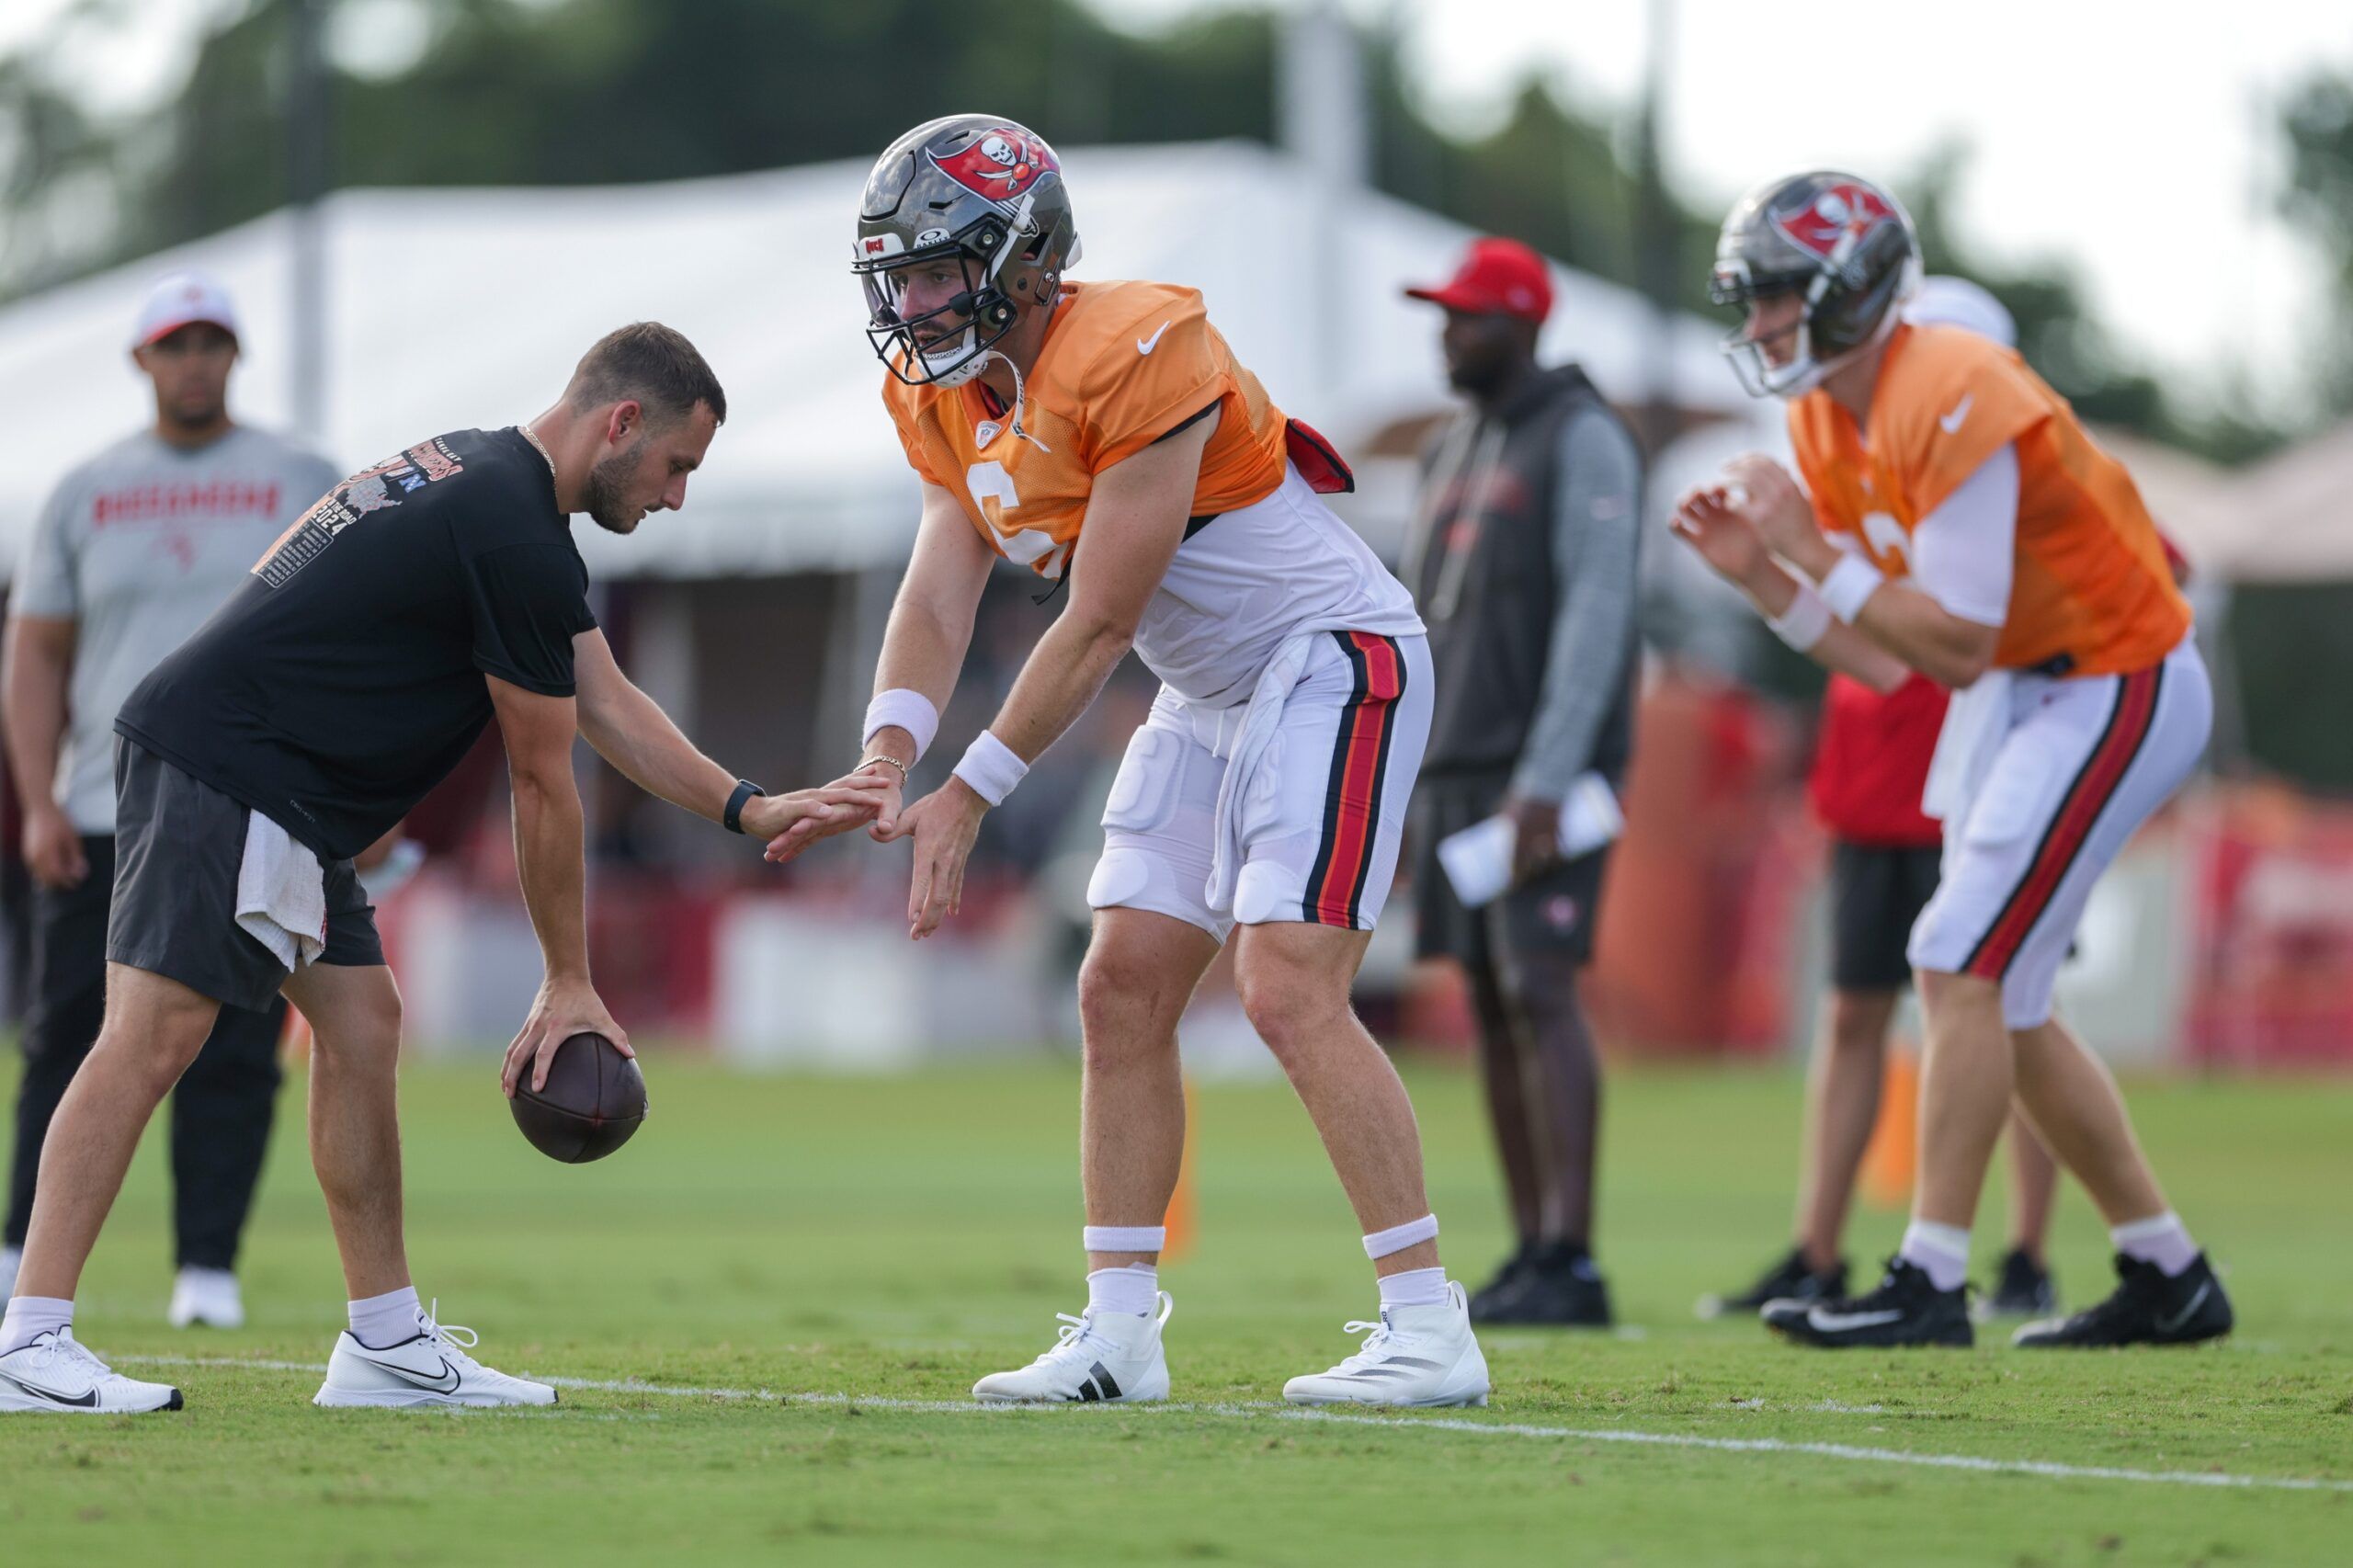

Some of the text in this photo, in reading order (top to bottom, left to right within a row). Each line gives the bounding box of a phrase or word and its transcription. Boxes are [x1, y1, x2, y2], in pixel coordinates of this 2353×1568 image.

[313, 505, 347, 537] 2024
[331, 500, 345, 513] THE
[338, 508, 358, 525] ROAD
